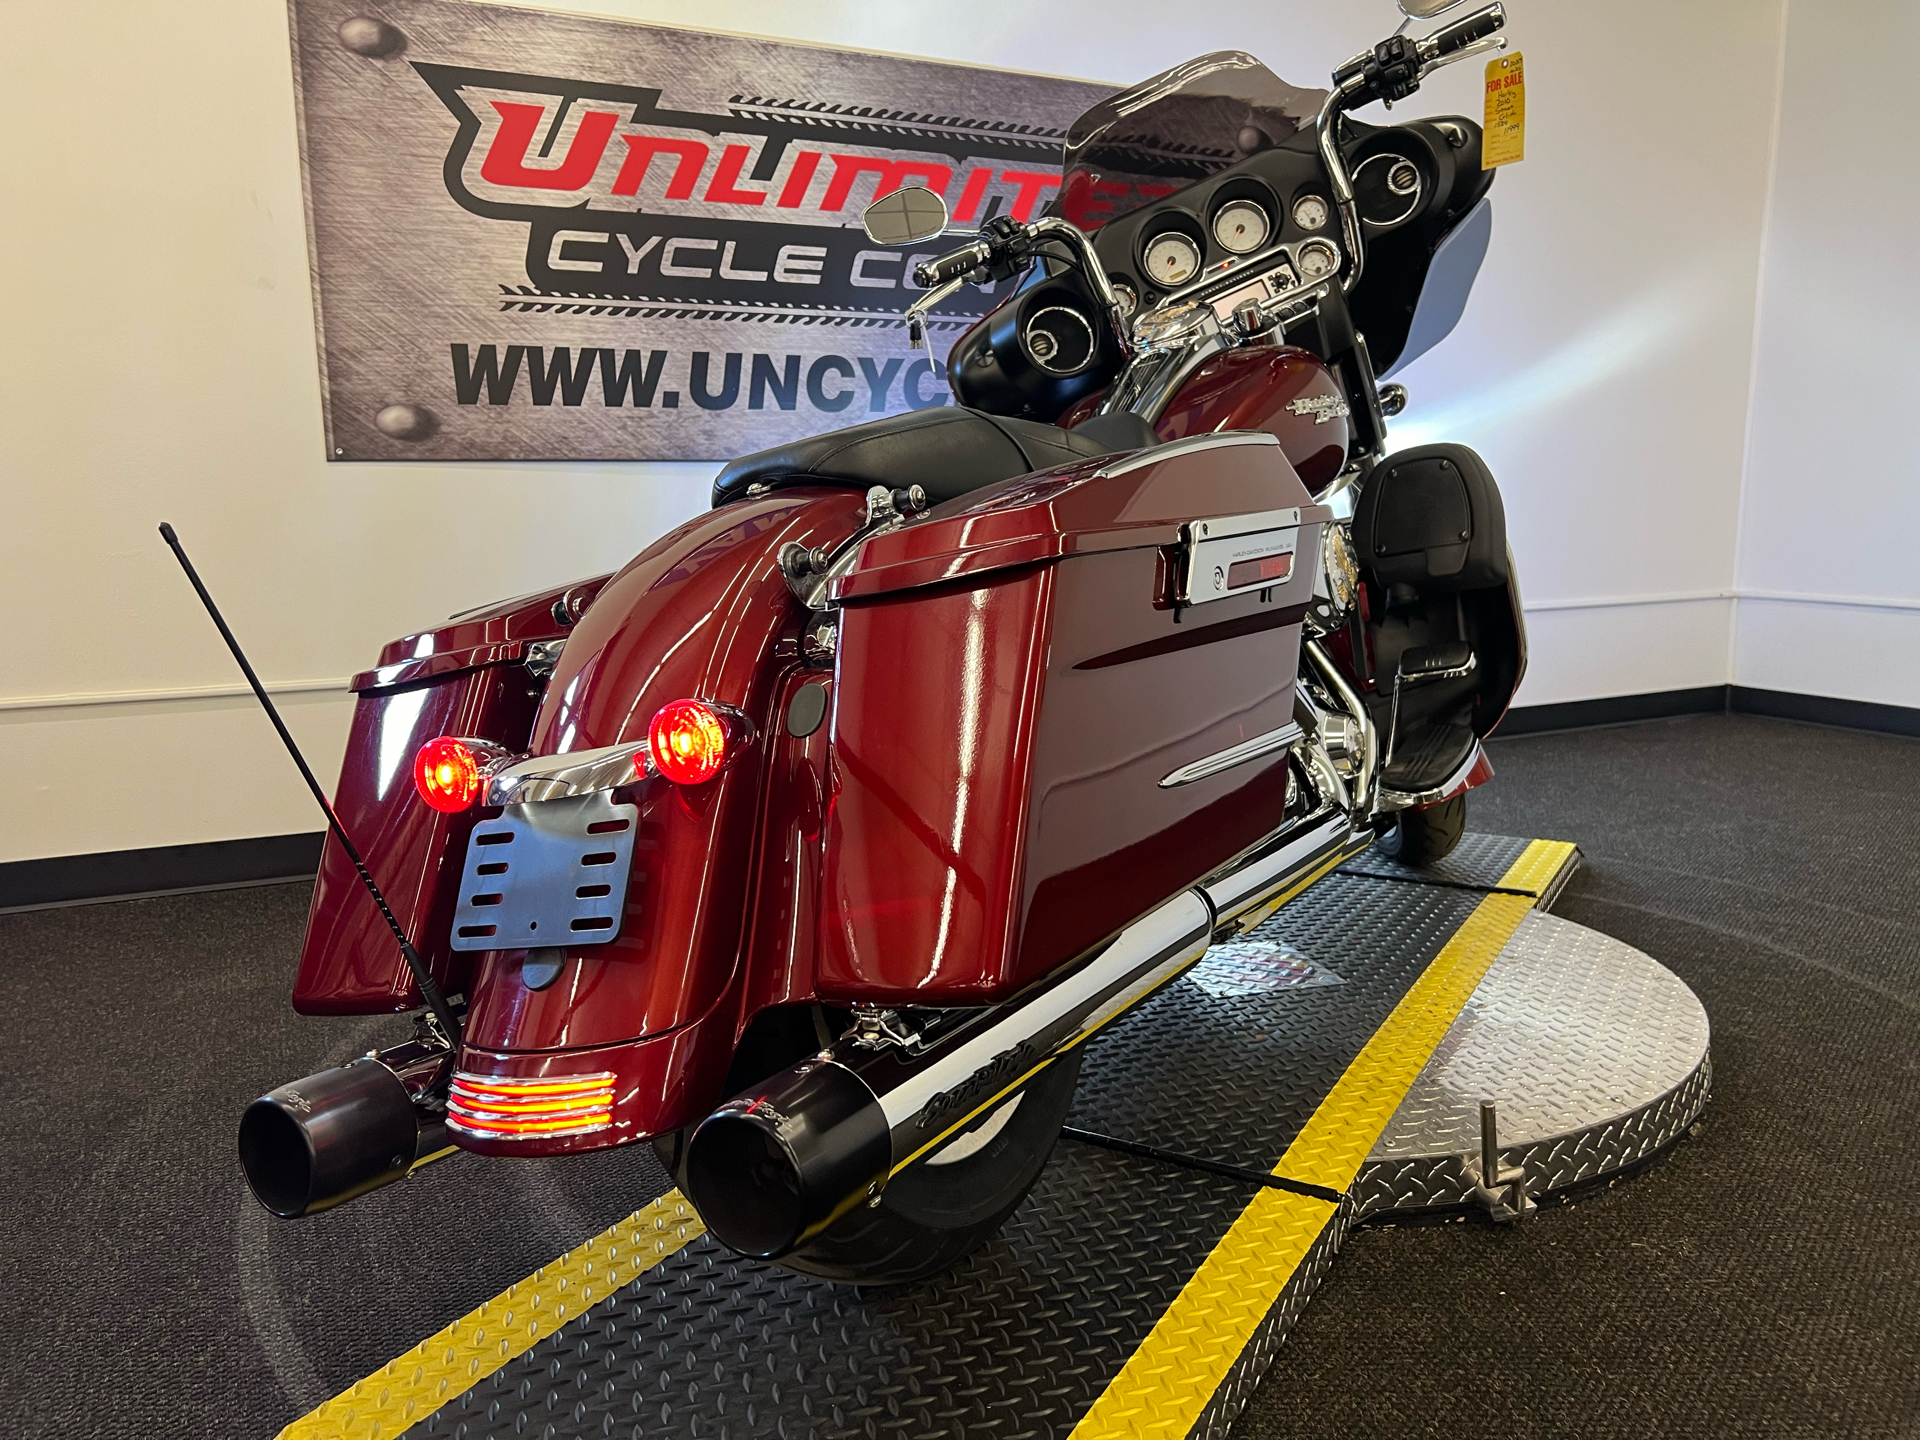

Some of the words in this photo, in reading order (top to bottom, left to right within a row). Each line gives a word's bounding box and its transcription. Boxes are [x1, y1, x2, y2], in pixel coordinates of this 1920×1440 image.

[1486, 79, 1501, 93] FOR
[1504, 72, 1522, 88] SALE
[480, 100, 1181, 232] UNLIMITE
[547, 229, 827, 284] CYCLE
